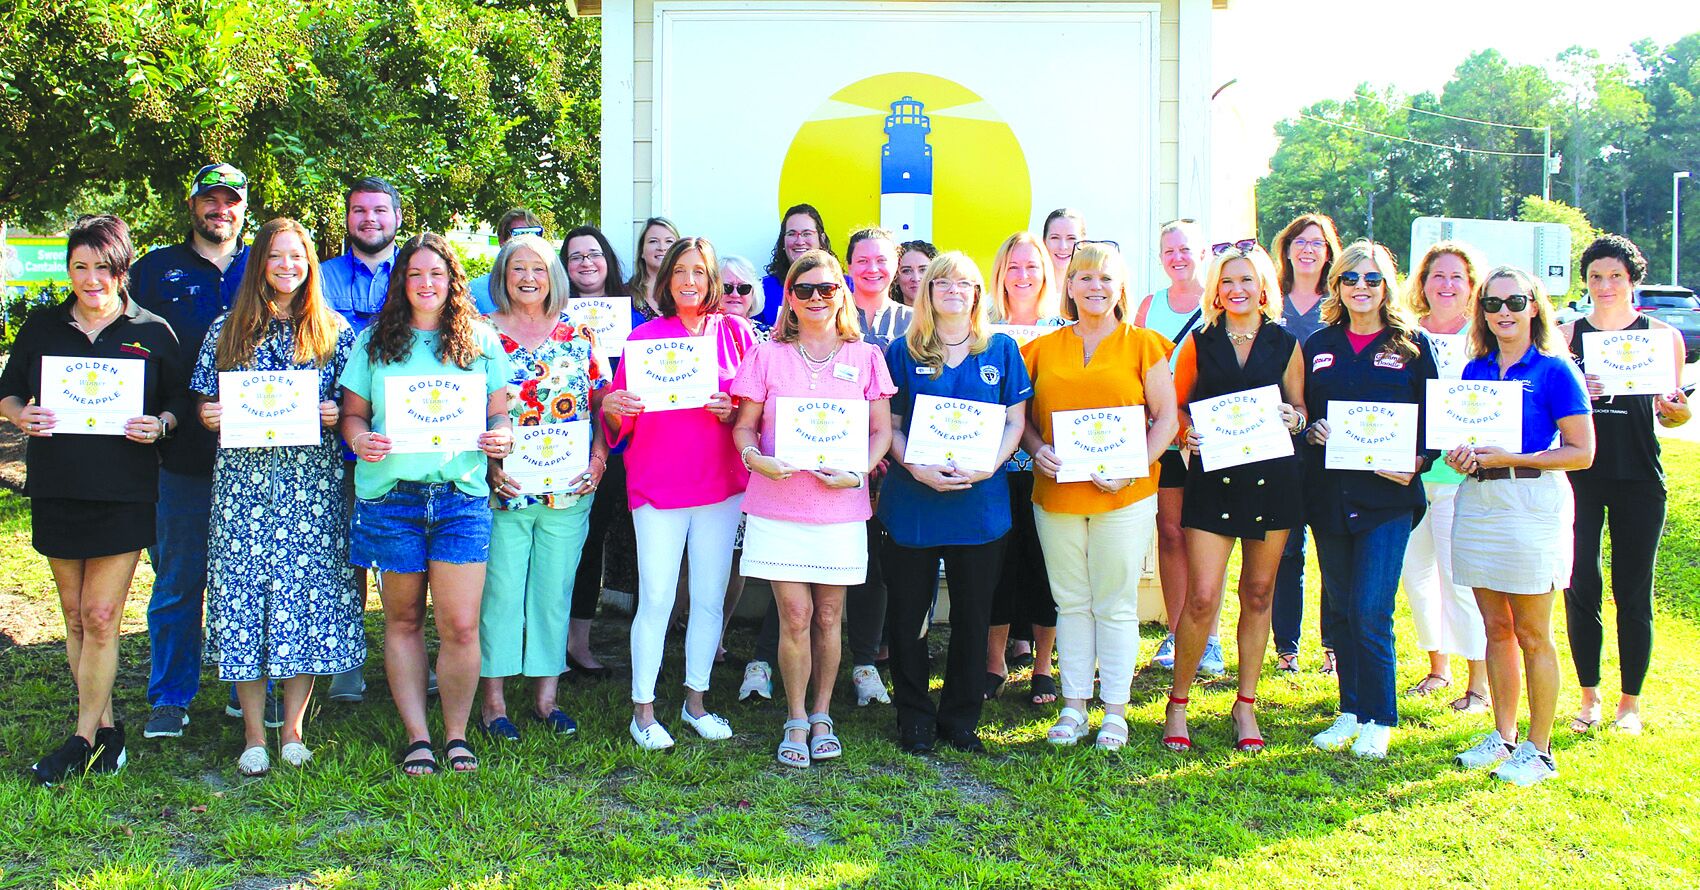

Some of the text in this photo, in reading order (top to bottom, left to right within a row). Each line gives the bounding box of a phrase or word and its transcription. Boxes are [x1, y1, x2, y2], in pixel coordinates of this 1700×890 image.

[574, 300, 612, 310] GOLDEN
[1604, 334, 1649, 346] GOLDEN
[646, 342, 694, 354] GOLDEN
[66, 362, 118, 374] GOLDEN
[1604, 356, 1654, 370] PINEAPPLE
[242, 374, 294, 387] GOLDEN
[646, 367, 698, 382] PINEAPPLE
[408, 380, 460, 392] GOLDEN
[1448, 384, 1498, 396] GOLDEN
[63, 389, 121, 405] PINEAPPLE
[1212, 396, 1257, 412] GOLDEN
[242, 402, 298, 417] PINEAPPLE
[798, 402, 846, 414] GOLDEN
[936, 402, 982, 416] GOLDEN
[1348, 406, 1394, 417] GOLDEN
[408, 408, 464, 423] PINEAPPLE
[1074, 412, 1122, 425] GOLDEN
[1446, 409, 1501, 424] PINEAPPLE
[524, 428, 569, 440] GOLDEN
[930, 424, 980, 440] PINEAPPLE
[1216, 418, 1266, 436] PINEAPPLE
[796, 428, 848, 442] PINEAPPLE
[1346, 430, 1396, 444] PINEAPPLE
[1074, 437, 1126, 452] PINEAPPLE
[522, 450, 572, 466] PINEAPPLE
